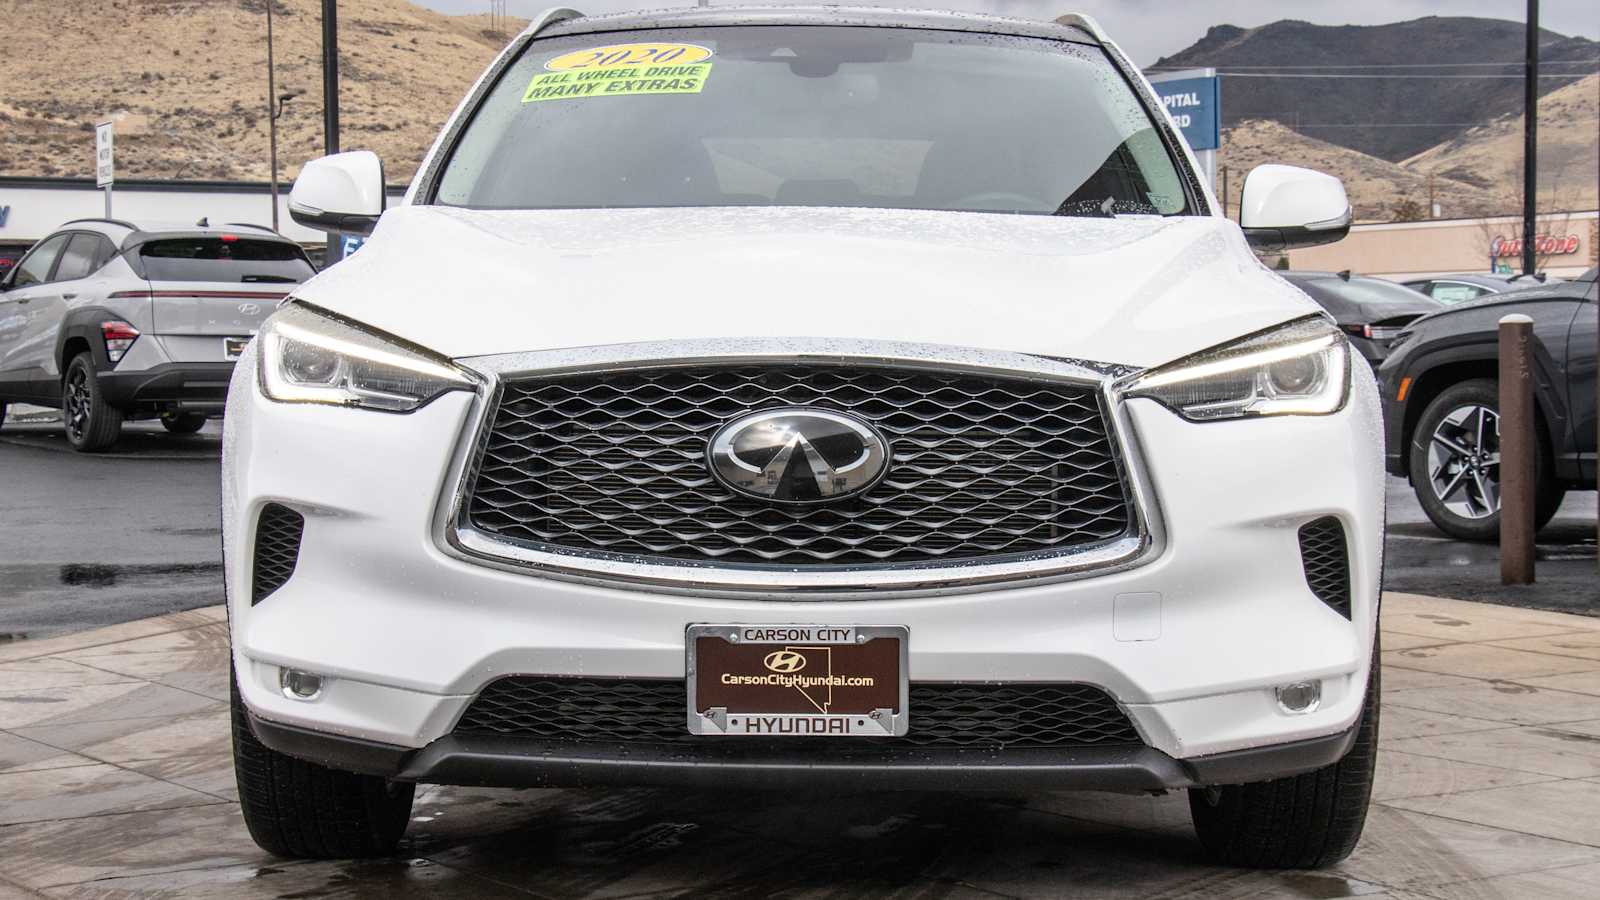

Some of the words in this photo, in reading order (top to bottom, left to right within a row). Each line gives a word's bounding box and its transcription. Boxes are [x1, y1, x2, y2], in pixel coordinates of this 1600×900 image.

[571, 47, 686, 67] 2020
[536, 75, 571, 86] ALL
[577, 68, 641, 80] WHEEL
[643, 66, 702, 77] DRIVE
[527, 81, 600, 99] MANY
[604, 78, 699, 92] EXTRAS
[1161, 92, 1201, 108] PITAL
[1172, 114, 1191, 128] RD
[744, 629, 811, 641] CARSON
[817, 629, 851, 641] CITY
[721, 673, 874, 688] CarsonCityHyundai.com
[746, 717, 850, 734] HYUNDAI
